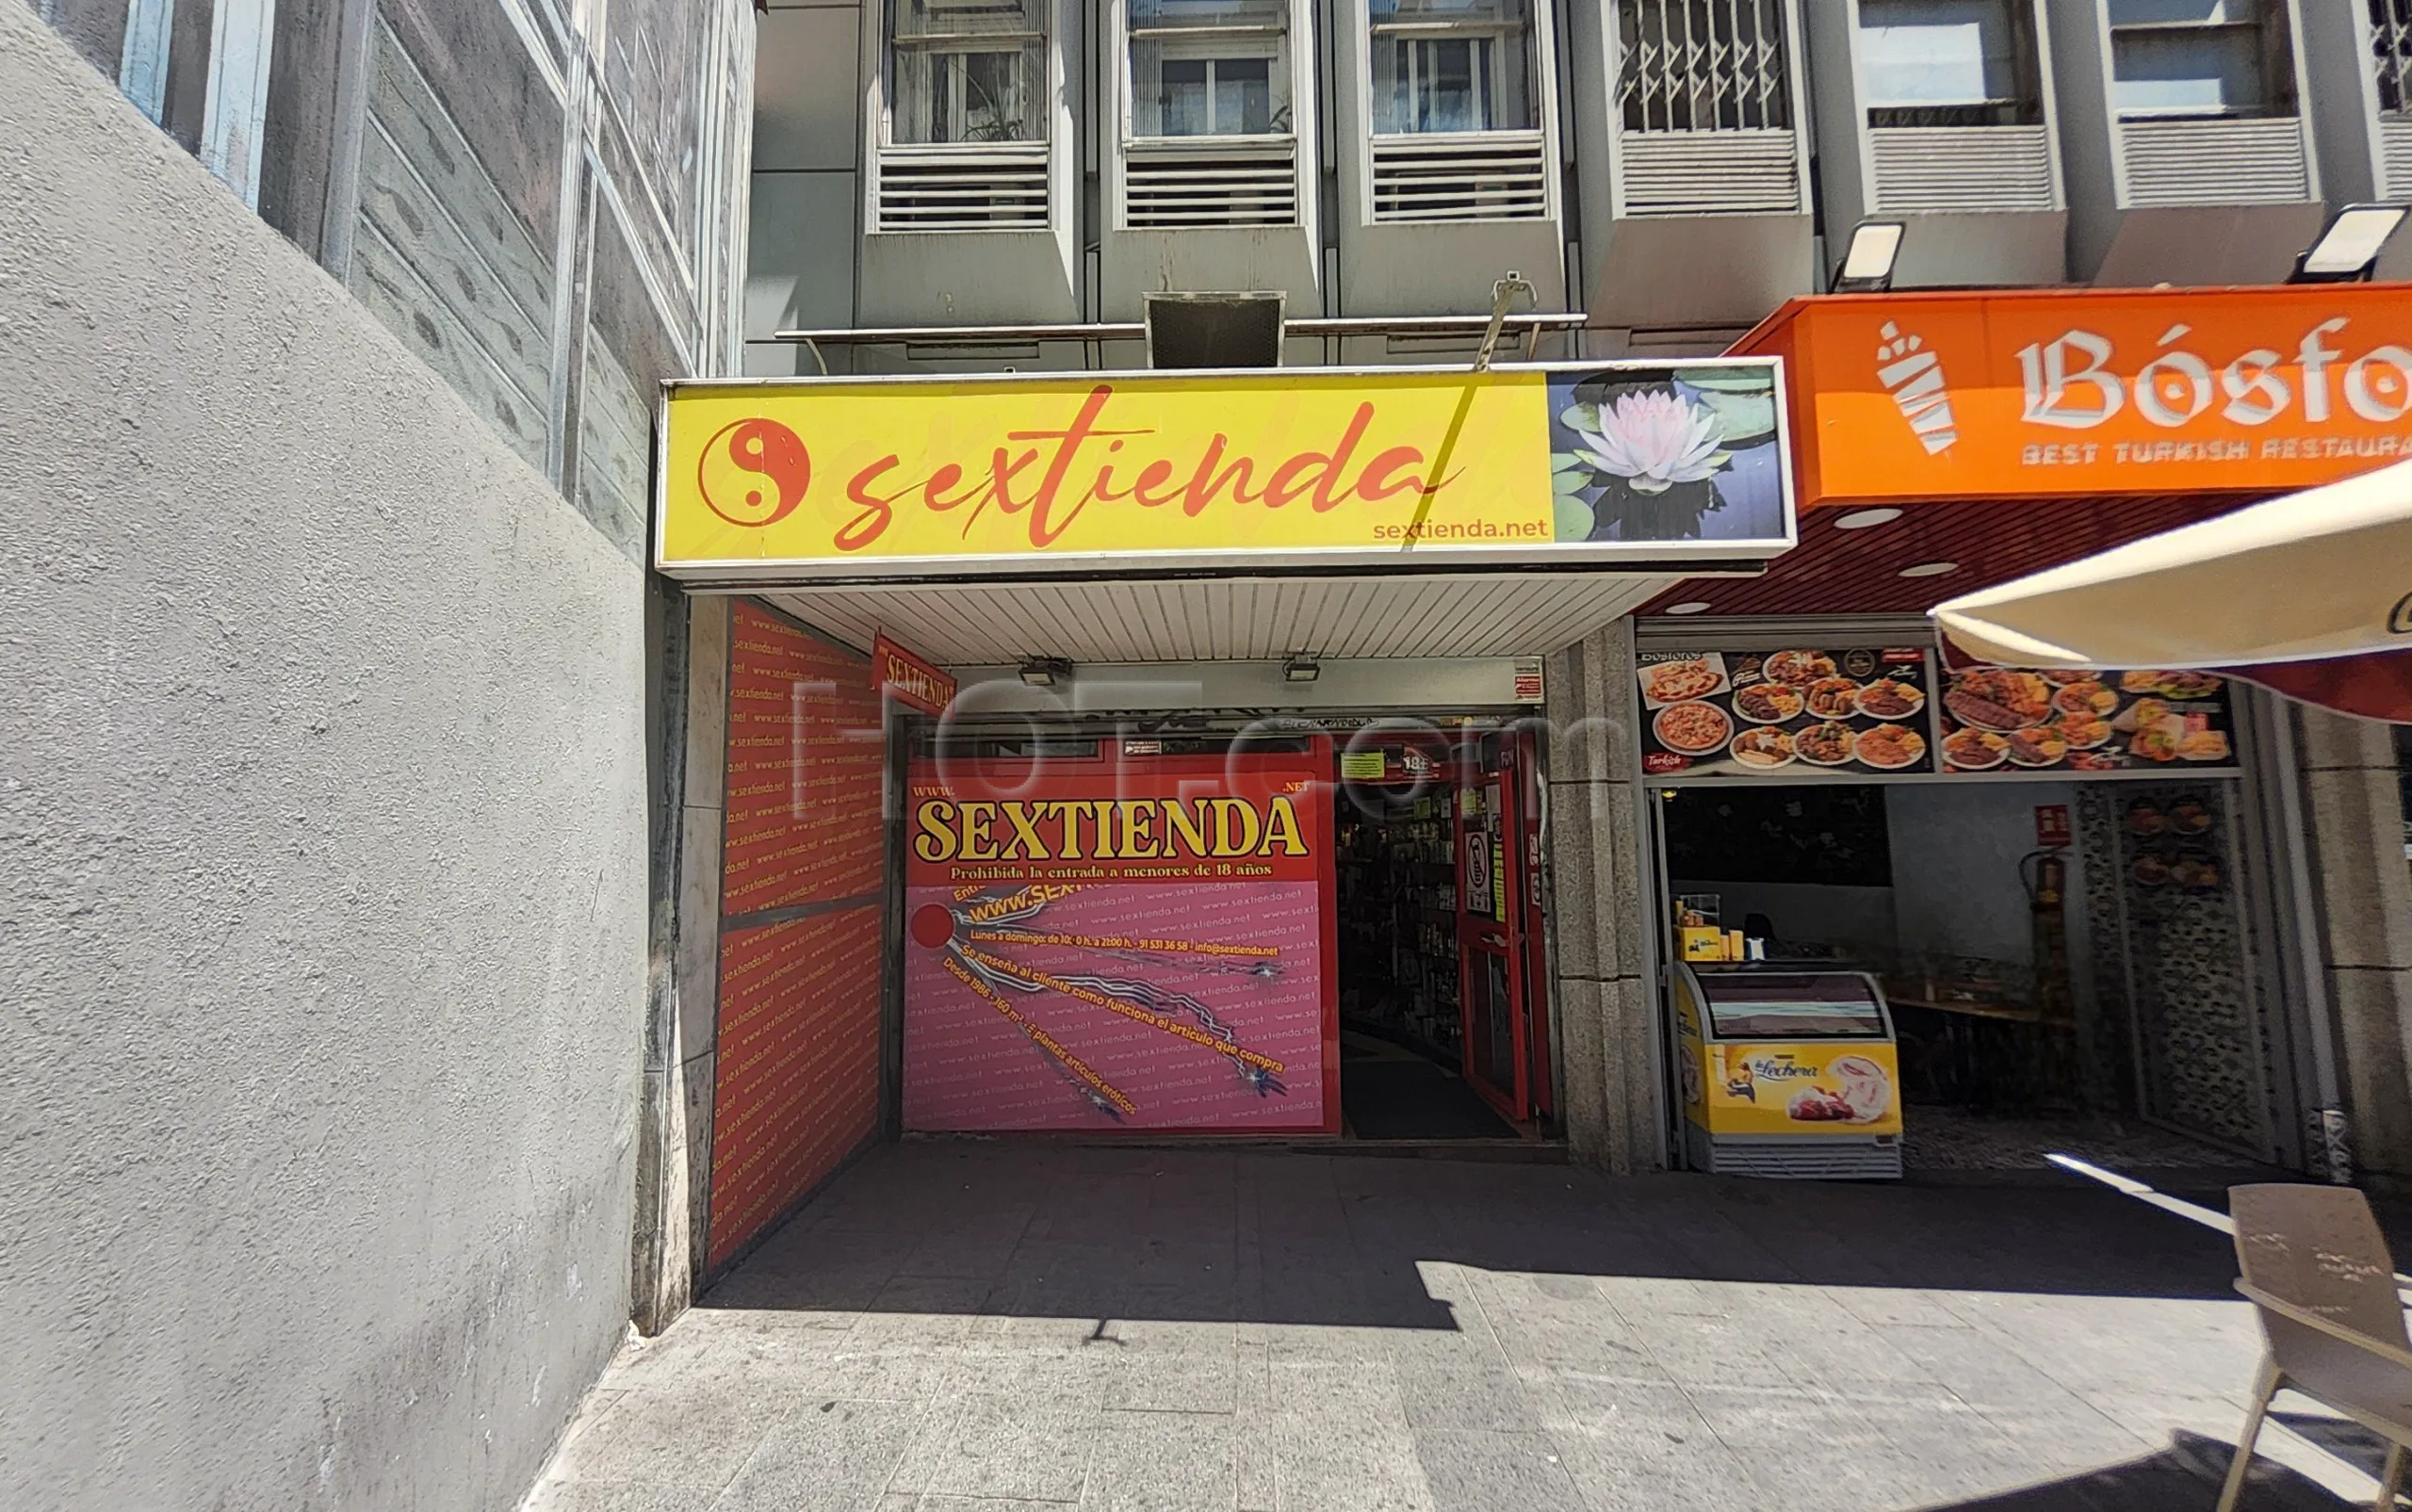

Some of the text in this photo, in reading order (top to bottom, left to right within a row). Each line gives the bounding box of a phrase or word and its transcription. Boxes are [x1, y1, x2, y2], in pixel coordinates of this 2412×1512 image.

[833, 384, 1467, 551] sextienda
[2022, 443, 2101, 465] BEST
[2113, 439, 2250, 463] TURKISH
[1373, 518, 1548, 541] sextienda.net
[912, 796, 1311, 863] SEXTIENDA
[950, 863, 1272, 880] Prohibida la entrada a menores de 18 años
[970, 930, 996, 940] Lunes
[999, 932, 1004, 940] a
[1005, 932, 1046, 944] domingo:
[1048, 934, 1059, 944] de
[1060, 935, 1082, 945] 10:0
[1093, 937, 1100, 946] a
[1139, 939, 1148, 949] 91
[1149, 940, 1163, 949] 531
[1165, 940, 1175, 950] 36
[1177, 941, 1187, 951] 58
[1195, 941, 1279, 956] info@sextienda.net
[942, 956, 970, 982] Desde
[970, 974, 990, 998] 1986
[994, 997, 1010, 1013] 160
[1034, 1029, 1067, 1060] plantas
[961, 945, 976, 957] Se
[977, 952, 1018, 973] enseña
[1019, 966, 1032, 978] al
[1032, 969, 1071, 994] cliente
[1072, 986, 1104, 1006] como
[1105, 998, 1155, 1025] funciona
[1157, 1017, 1168, 1029] el
[1214, 1039, 1238, 1054] que
[1239, 1048, 1283, 1073] compra
